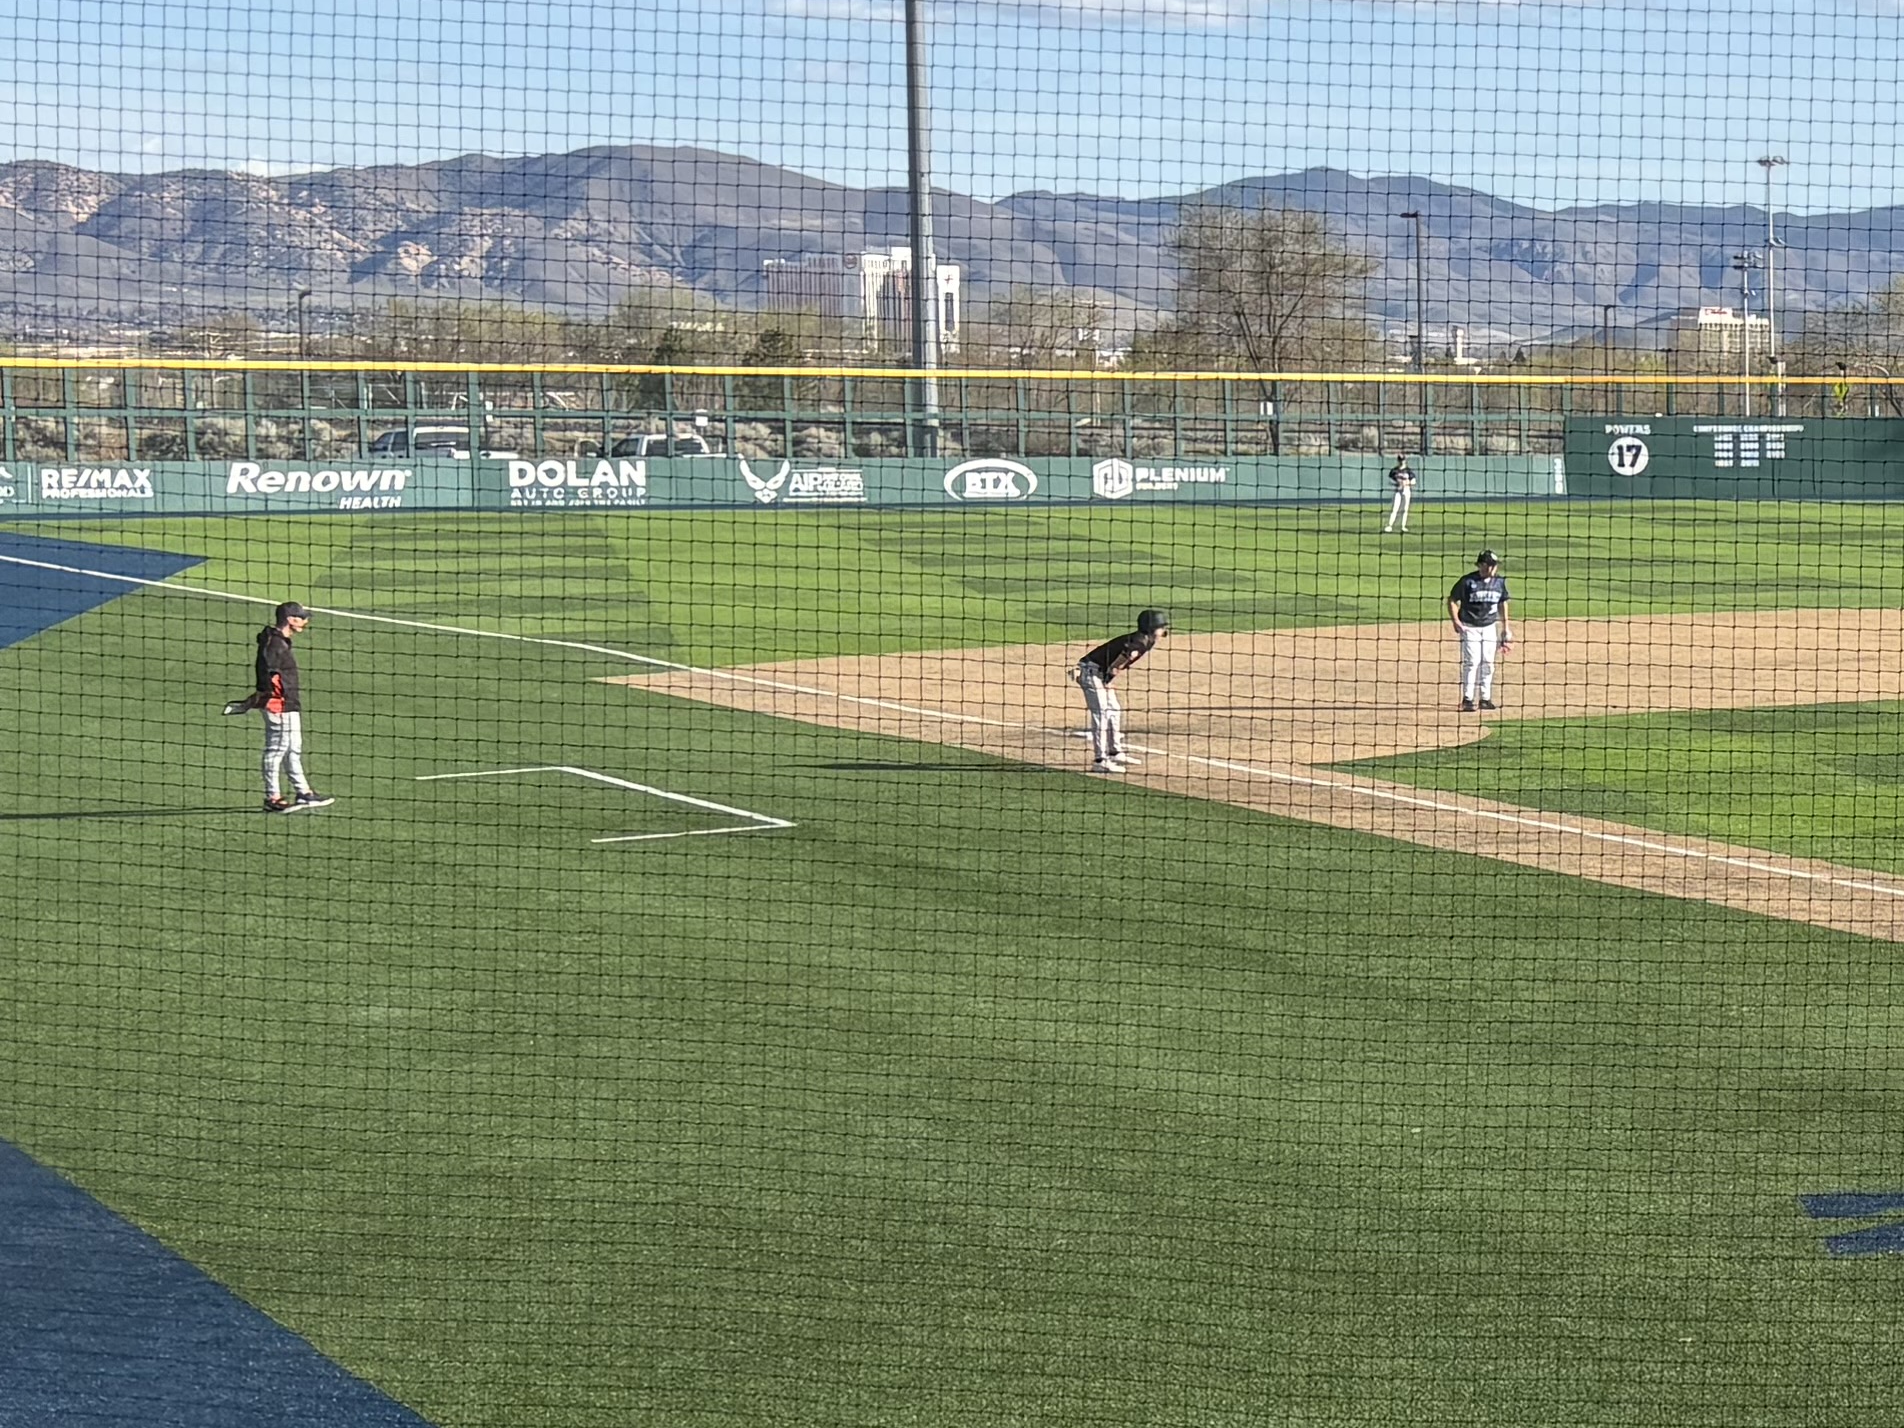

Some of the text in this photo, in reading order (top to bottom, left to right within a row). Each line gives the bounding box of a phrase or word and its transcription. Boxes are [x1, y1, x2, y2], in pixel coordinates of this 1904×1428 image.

[1616, 444, 1642, 468] 17
[41, 468, 152, 488] RE/MAX
[226, 461, 407, 494] Renown
[508, 460, 646, 487] DOLAN
[1135, 467, 1226, 482] PLENIUM
[42, 487, 154, 499] PROFESSIONALS
[510, 488, 646, 499] AUTO GROUP
[339, 496, 402, 510] HEALTH
